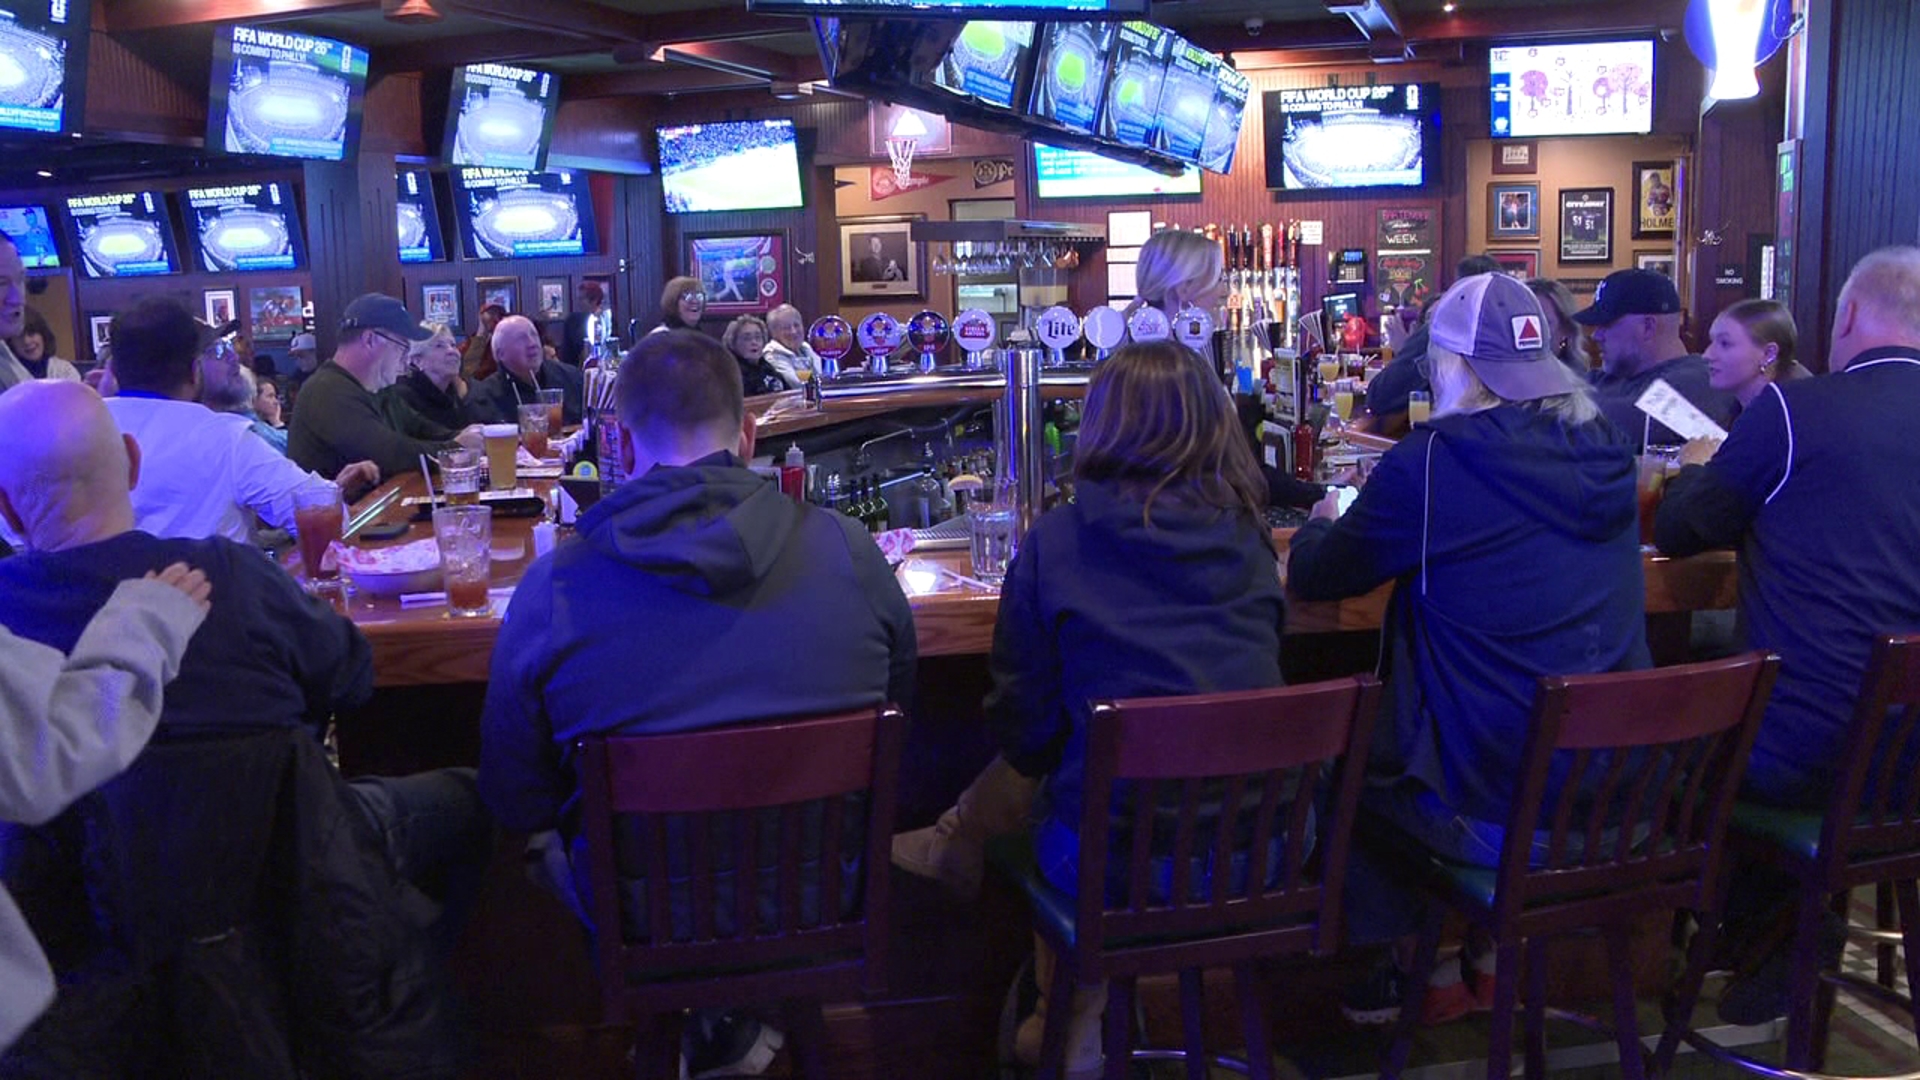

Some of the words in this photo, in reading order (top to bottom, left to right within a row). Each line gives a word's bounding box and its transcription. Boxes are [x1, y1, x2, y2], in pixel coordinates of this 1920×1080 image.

[233, 26, 256, 45] FIFA
[257, 30, 293, 50] WORLD
[294, 37, 314, 53] CUP
[240, 44, 270, 58] COMING
[484, 63, 507, 78] WORLD
[508, 67, 522, 80] CUP
[1280, 89, 1304, 103] FIFA
[1305, 87, 1346, 102] WORLD
[1347, 86, 1371, 100] CUP
[1280, 103, 1289, 113] IS
[1289, 102, 1322, 112] COMING
[1322, 101, 1333, 111] TO
[462, 167, 481, 180] FIFA
[472, 178, 495, 188] COMING
[188, 189, 205, 200] FIFA
[205, 187, 231, 198] WORLD
[231, 185, 247, 197] CUP
[67, 197, 84, 208] FIFA
[83, 195, 107, 206] WORLD
[107, 194, 122, 205] CUP
[1641, 217, 1675, 229] HOLME
[1385, 233, 1418, 244] WEEK
[1715, 277, 1744, 285] SMOKING
[1044, 319, 1075, 340] Lite
